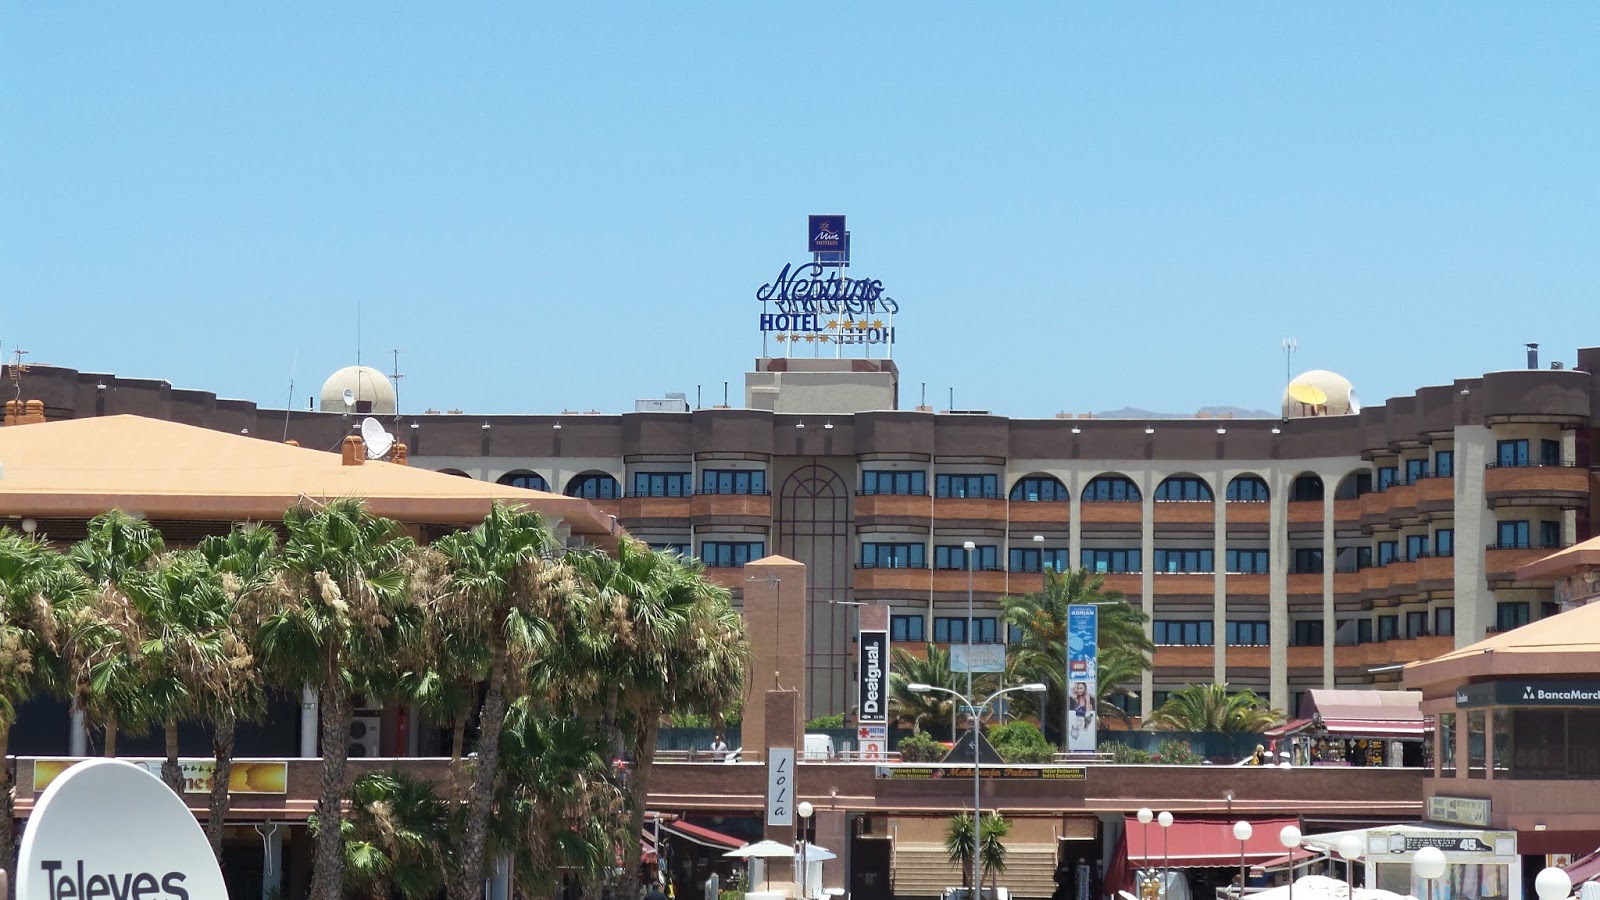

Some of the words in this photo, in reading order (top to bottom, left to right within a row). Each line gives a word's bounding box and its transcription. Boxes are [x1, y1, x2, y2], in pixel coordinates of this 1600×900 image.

[756, 262, 885, 309] Neptuno
[760, 313, 822, 332] HOTEL
[1460, 838, 1476, 851] 45
